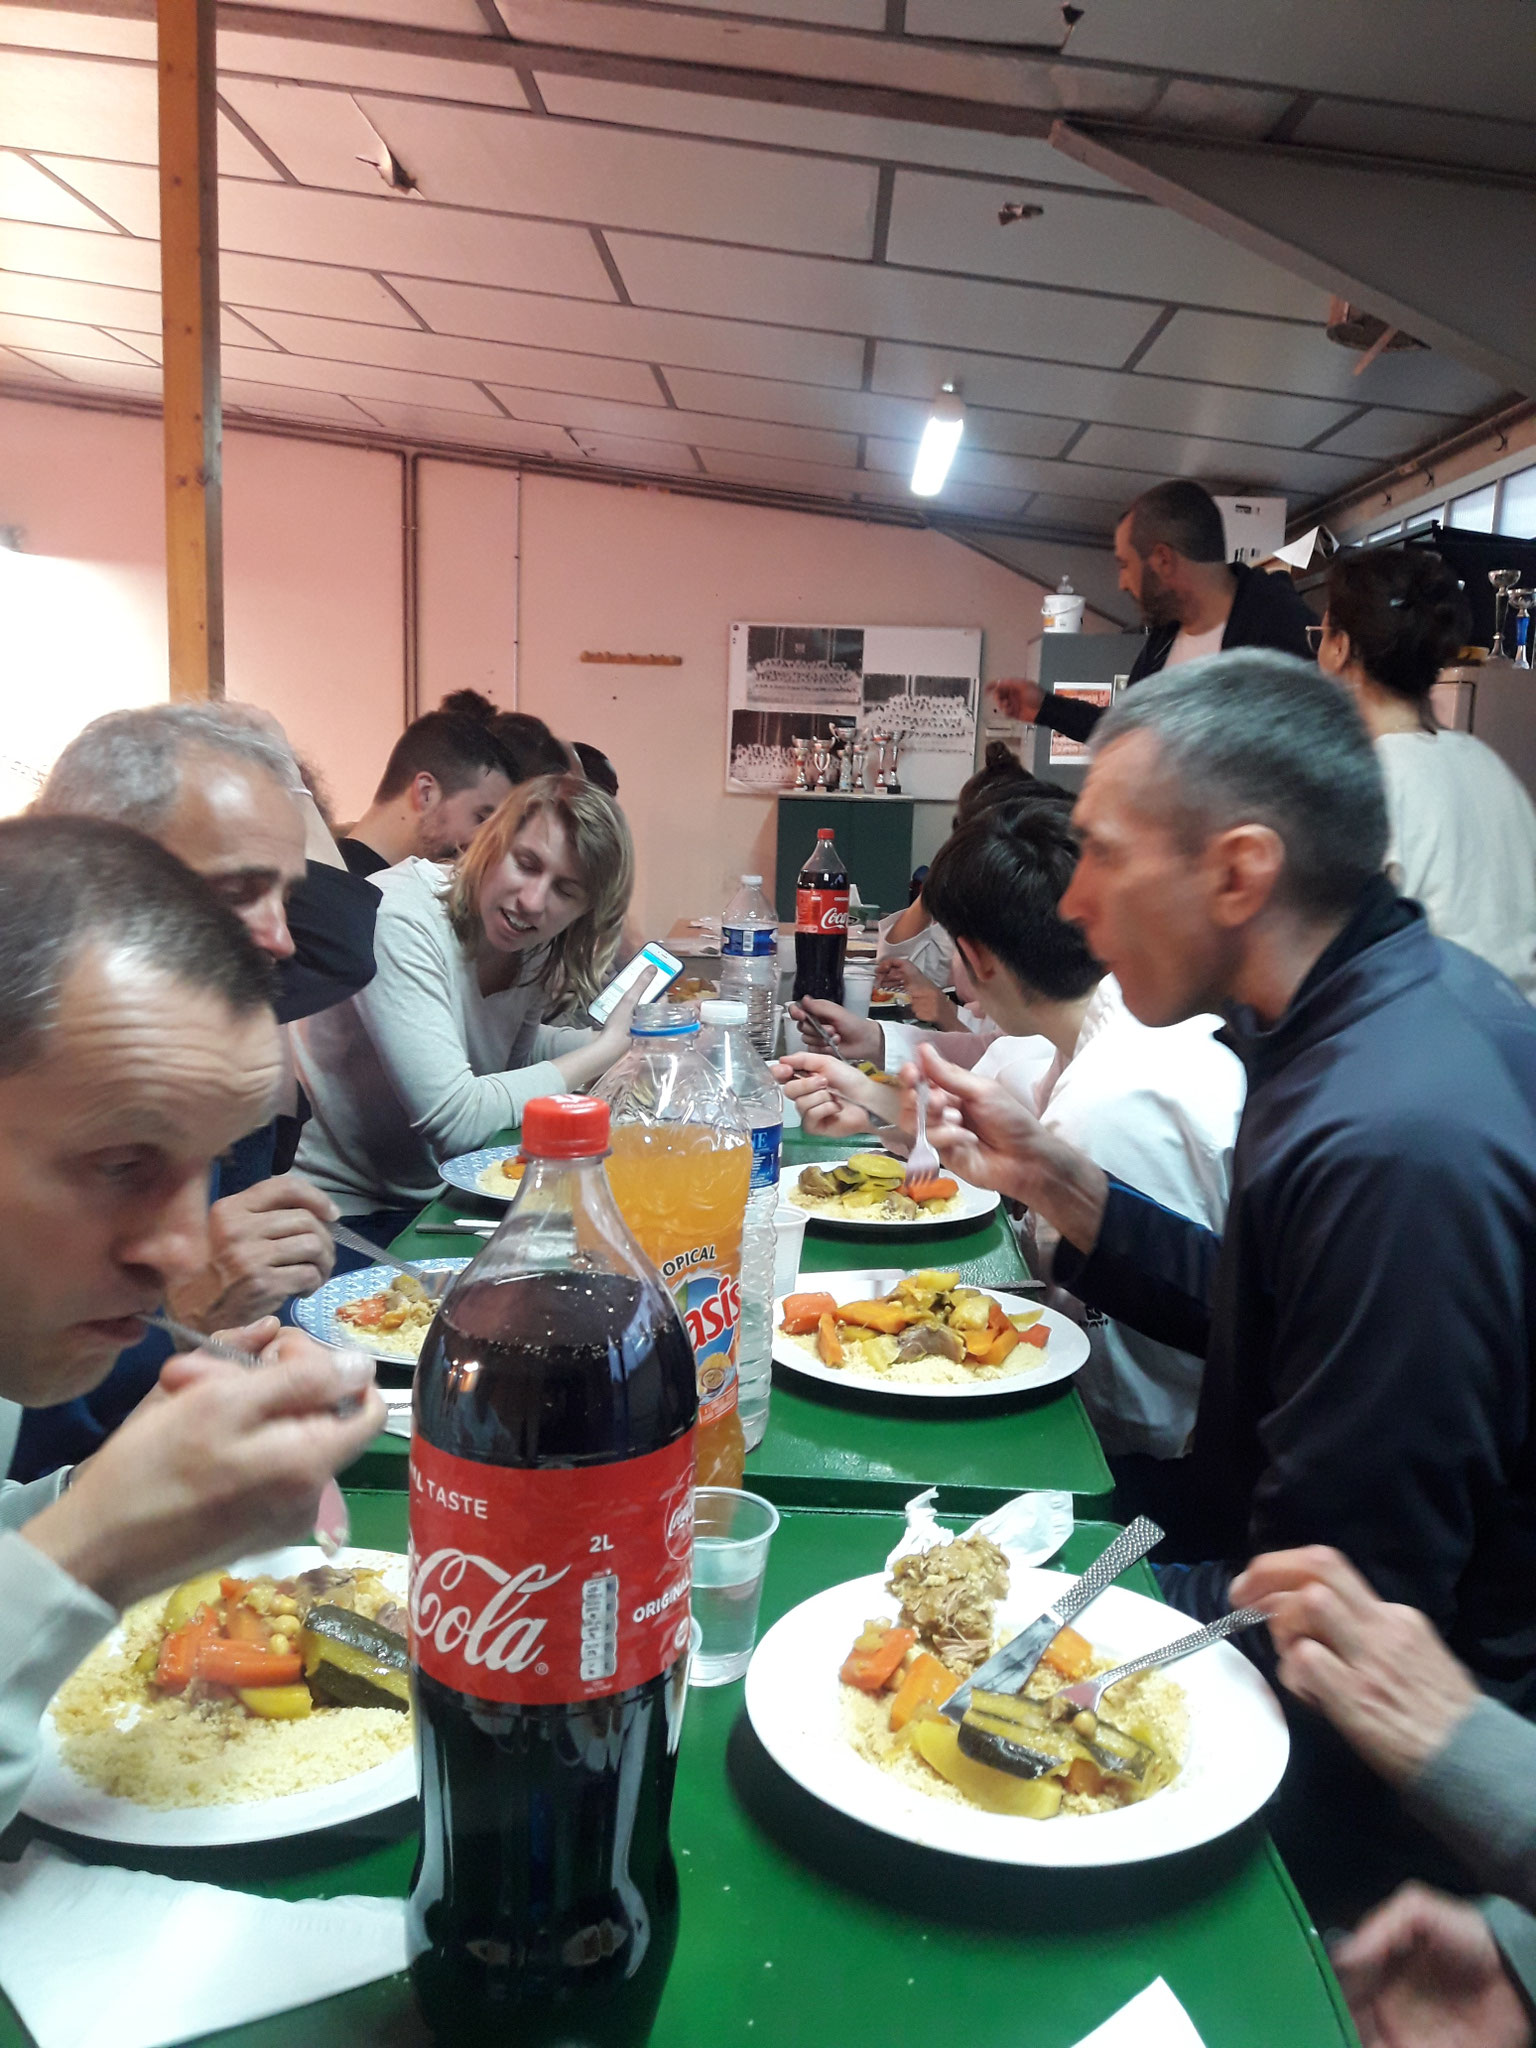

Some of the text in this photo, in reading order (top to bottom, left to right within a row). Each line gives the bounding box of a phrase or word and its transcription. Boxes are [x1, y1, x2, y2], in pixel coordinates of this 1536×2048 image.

[662, 1245, 717, 1278] OPICAL
[683, 1275, 742, 1353] asis
[426, 1478, 488, 1520] TASTE
[589, 1534, 615, 1553] 2L
[410, 1547, 572, 1673] Cola
